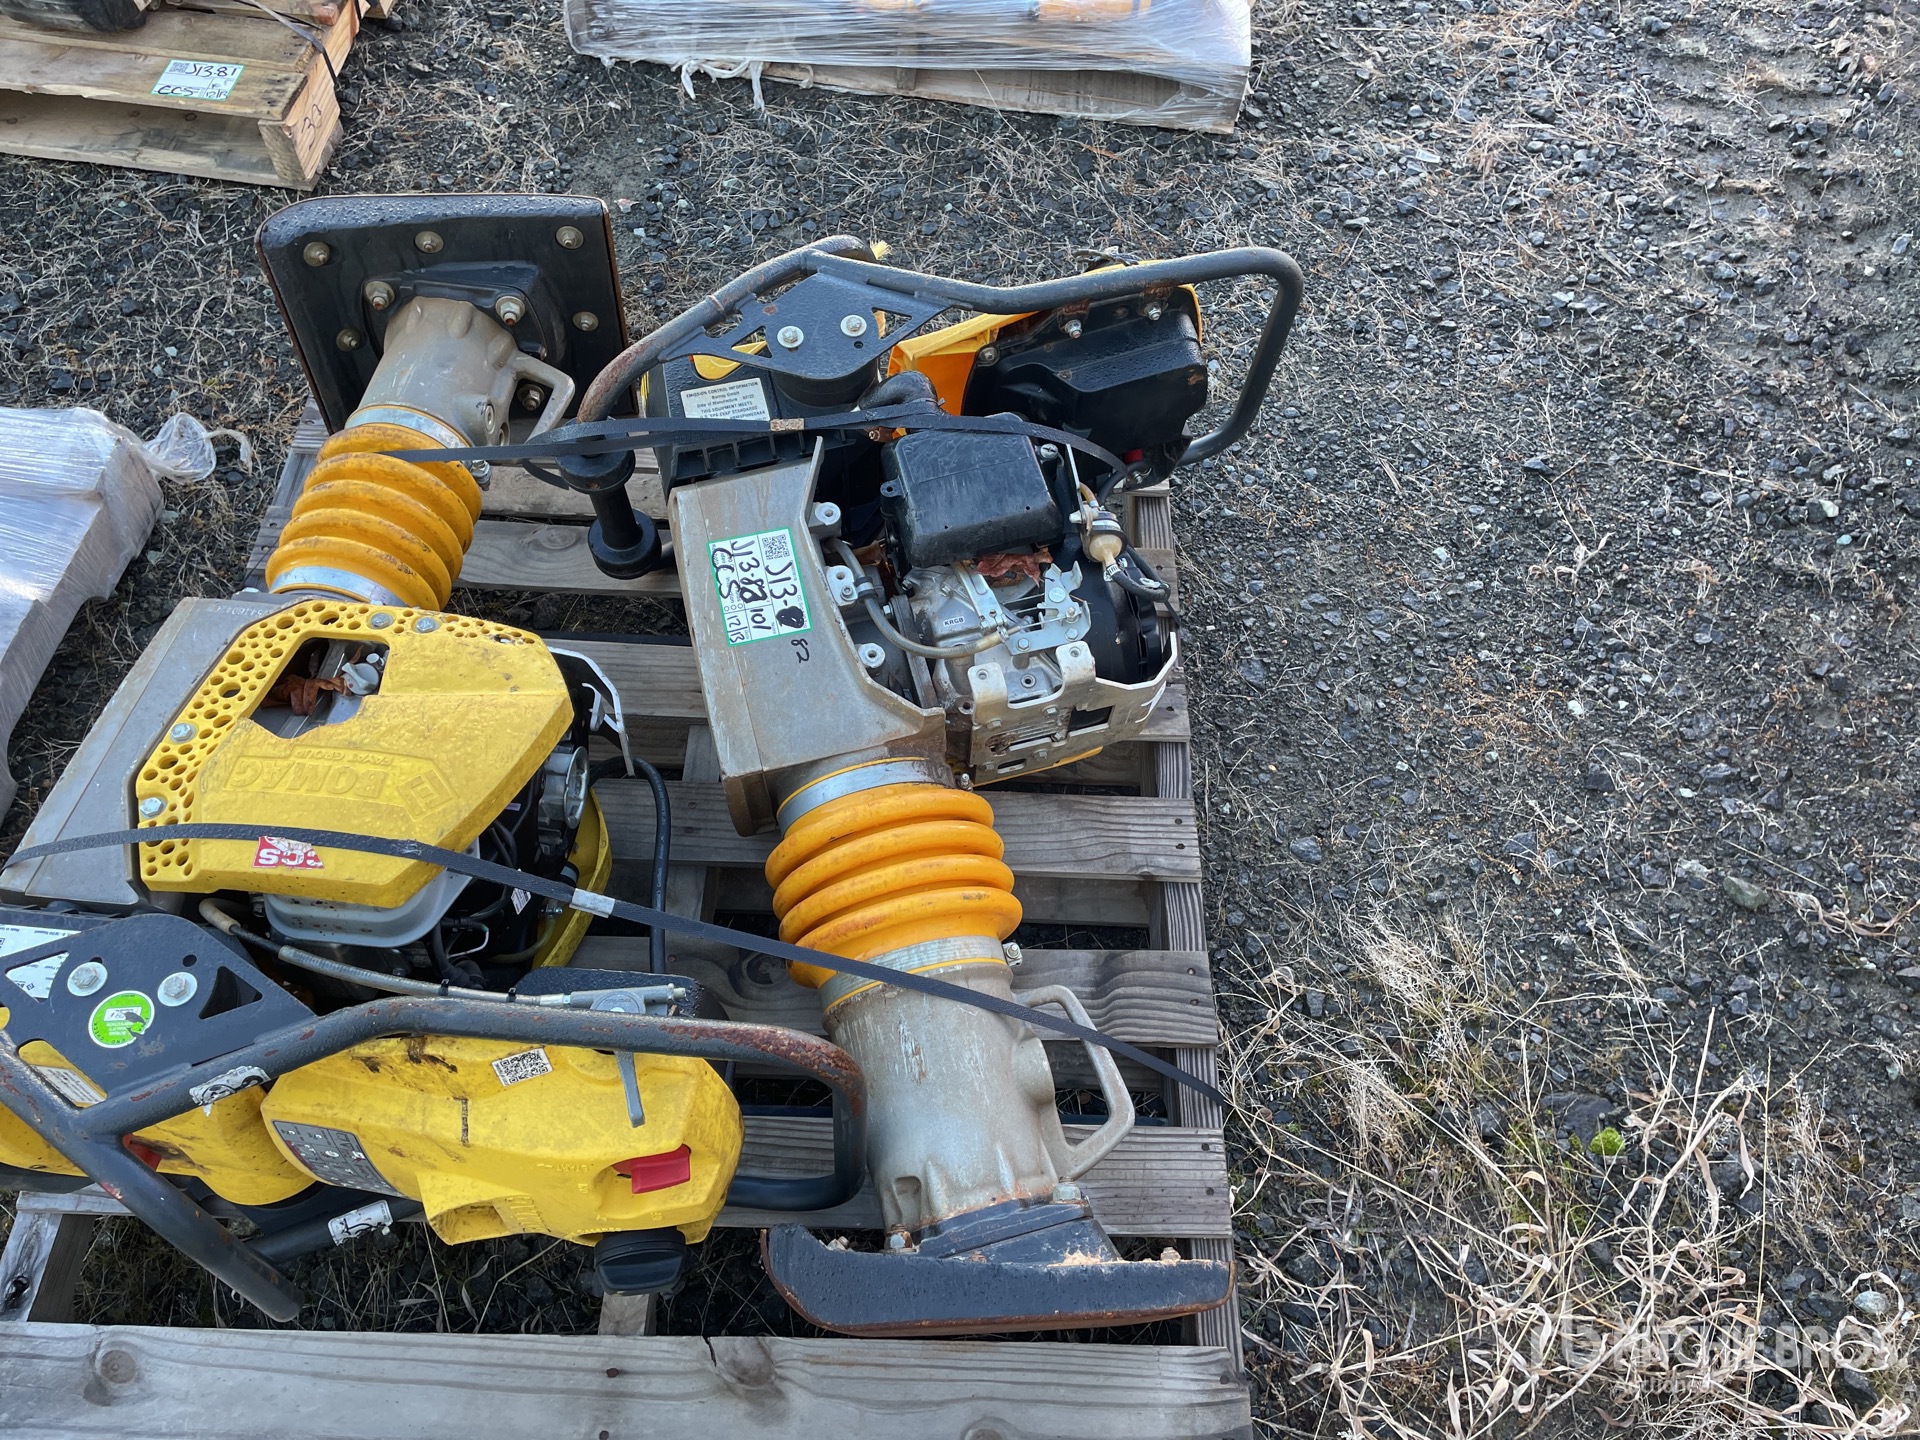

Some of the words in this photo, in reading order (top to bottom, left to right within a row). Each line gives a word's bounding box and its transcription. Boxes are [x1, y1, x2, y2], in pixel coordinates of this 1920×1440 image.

[158, 85, 194, 96] CCS
[728, 382, 758, 390] INFORMATION
[712, 547, 742, 599] CCS
[230, 761, 390, 799] BOMAG
